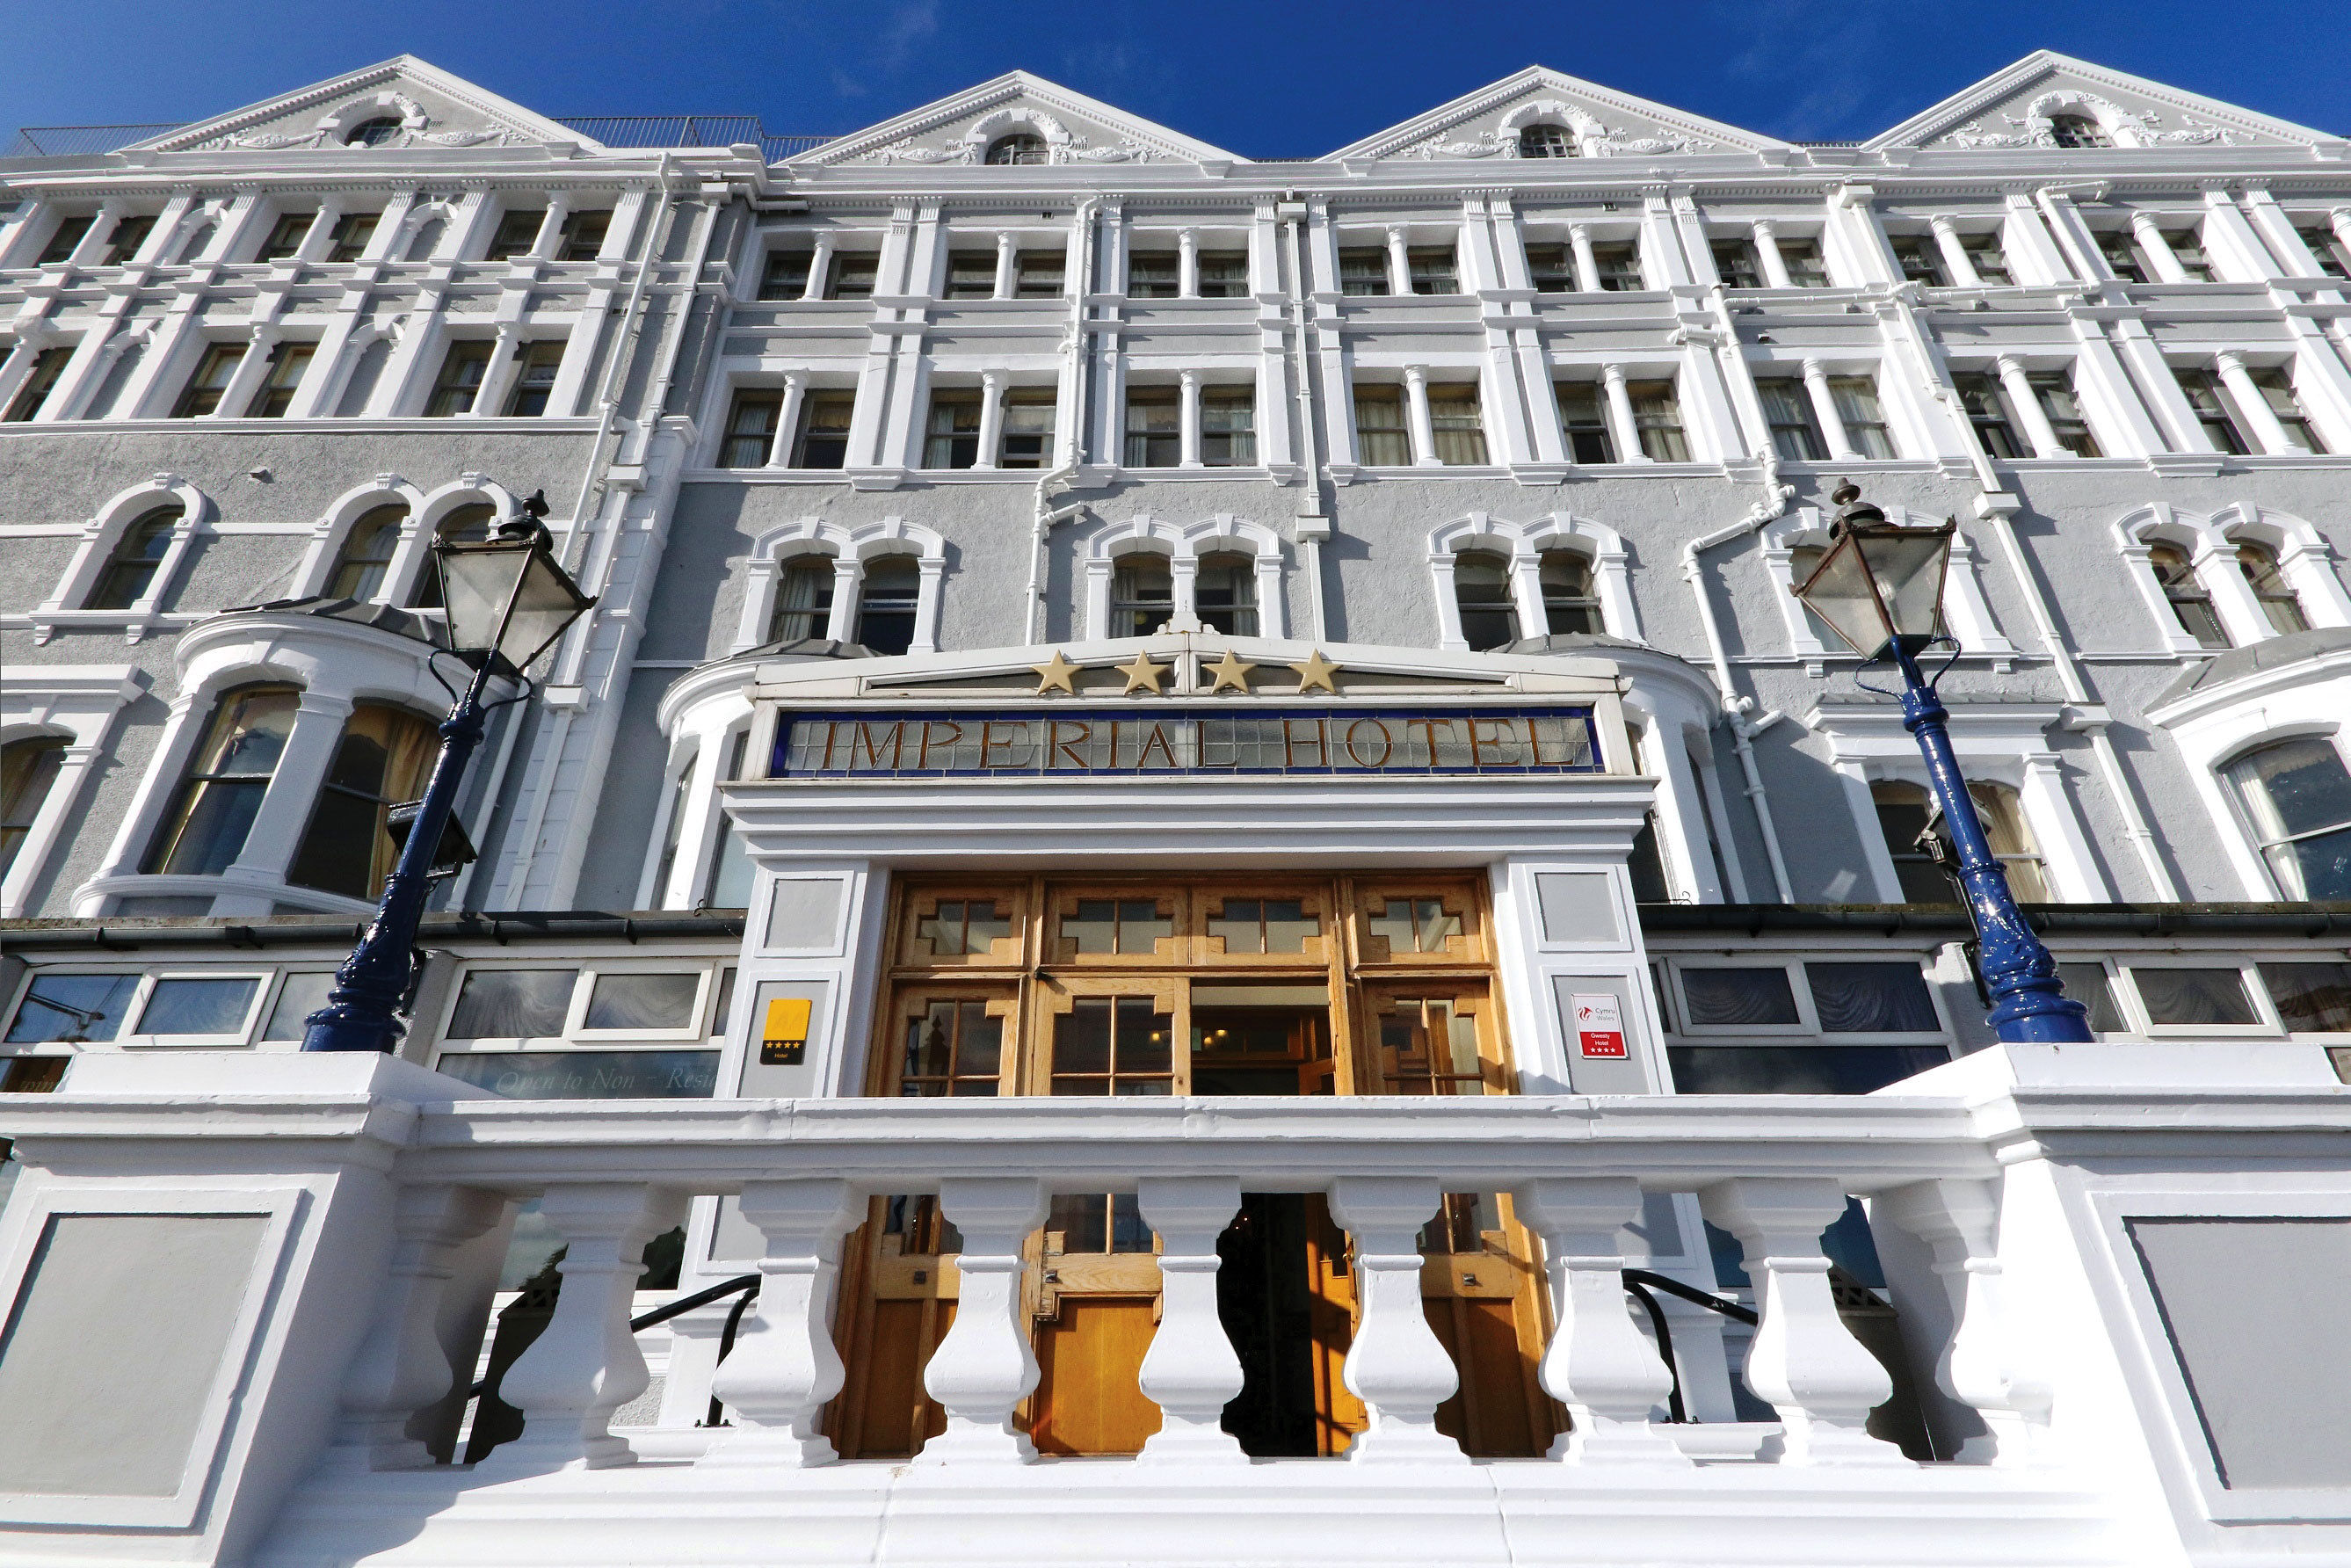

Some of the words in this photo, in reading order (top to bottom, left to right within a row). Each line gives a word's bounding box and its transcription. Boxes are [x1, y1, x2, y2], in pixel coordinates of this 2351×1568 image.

[821, 719, 1238, 770] IMPERIAL
[1283, 716, 1576, 768] HOTEL
[1595, 1007, 1615, 1016] Cymru
[496, 1071, 555, 1095] Open
[563, 1071, 583, 1090] to
[591, 1068, 635, 1090] Non
